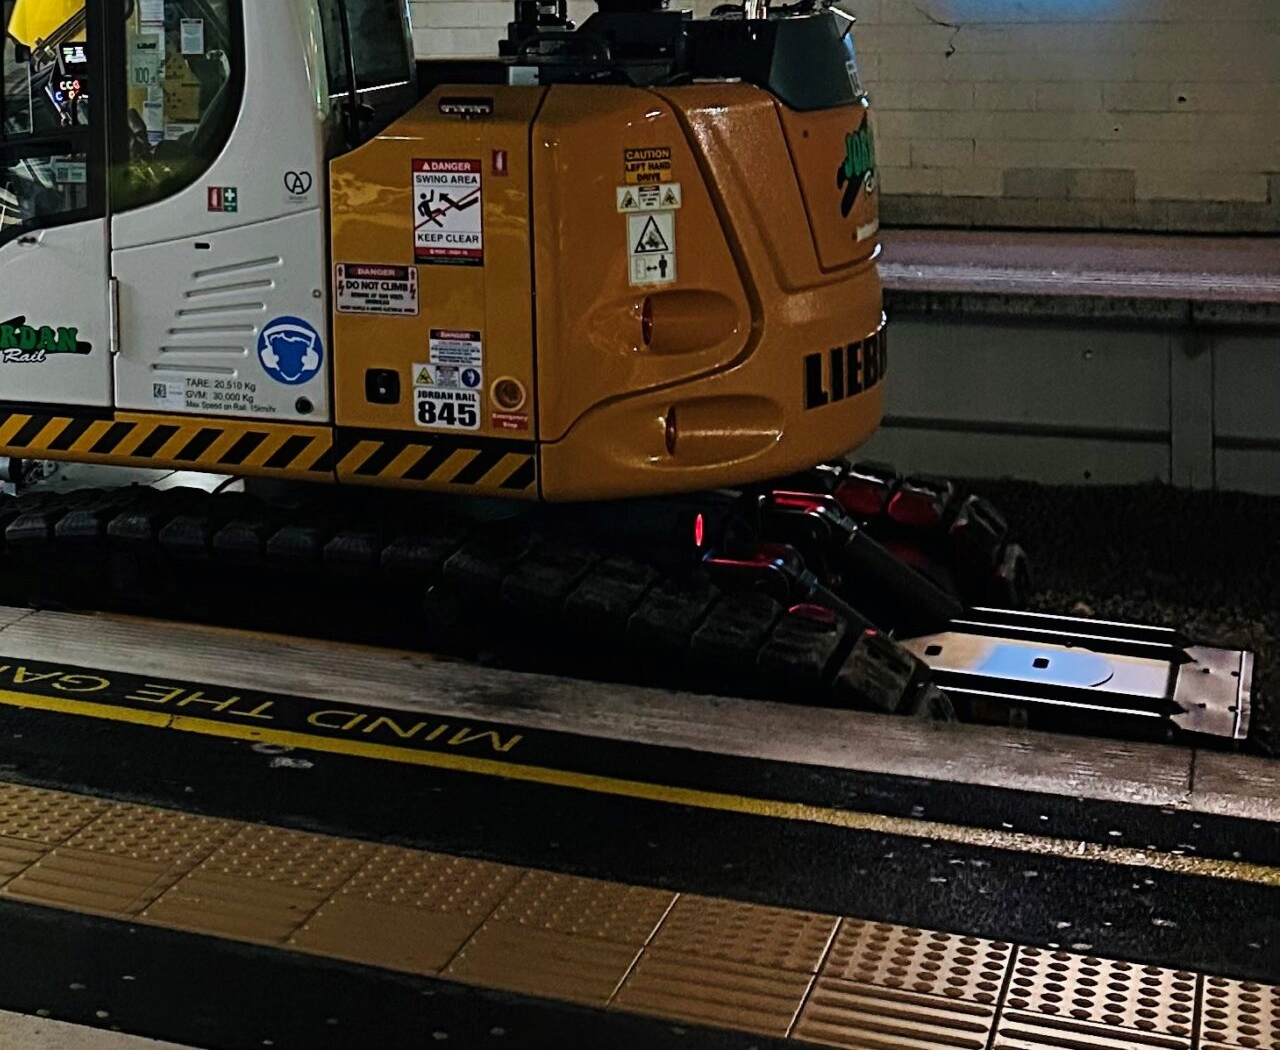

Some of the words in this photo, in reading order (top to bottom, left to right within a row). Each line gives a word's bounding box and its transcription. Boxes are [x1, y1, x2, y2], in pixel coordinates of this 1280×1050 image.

[626, 149, 670, 160] CAUTION
[432, 162, 471, 171] DANGER
[625, 162, 646, 172] LEFT
[647, 161, 671, 170] HAND
[415, 175, 448, 184] SWING
[450, 175, 478, 184] AREA
[637, 171, 661, 182] DRIVE
[417, 232, 444, 242] KEEP
[445, 233, 479, 244] CLEAR
[357, 268, 396, 277] DANGER
[345, 281, 360, 290] DO
[361, 281, 379, 290] NOT
[380, 281, 409, 292] CLIMB
[3, 348, 47, 364] Rail
[244, 381, 256, 393] Kg
[242, 393, 254, 404] Kg
[417, 390, 453, 400] JORDAN
[455, 392, 477, 402] RAIL
[185, 400, 199, 408] Max
[417, 400, 477, 427] 845
[125, 683, 275, 721] THE
[306, 708, 523, 753] MIND
